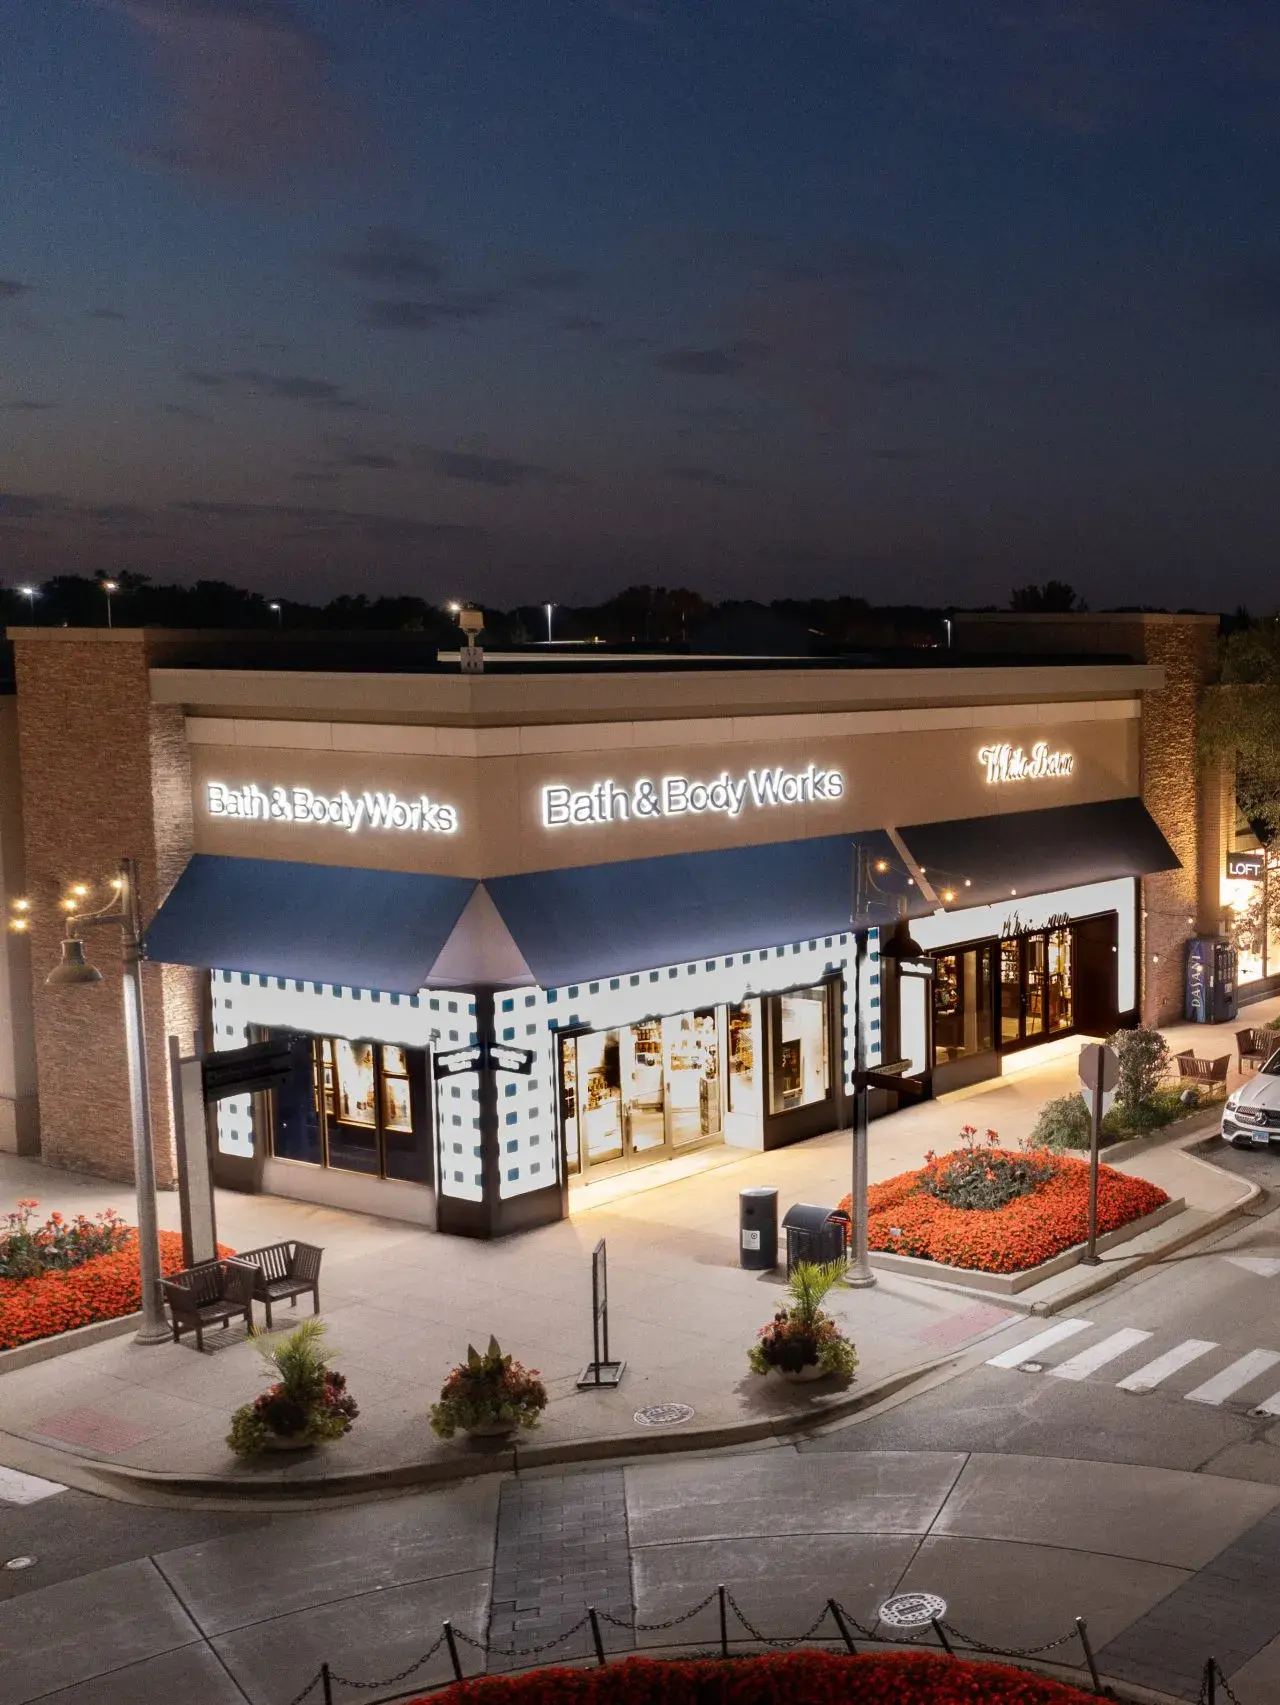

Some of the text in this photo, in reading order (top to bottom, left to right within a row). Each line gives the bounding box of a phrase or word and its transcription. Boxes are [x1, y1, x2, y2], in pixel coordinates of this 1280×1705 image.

[206, 782, 269, 819] Bath
[292, 787, 362, 833] Body
[362, 791, 460, 834] Works
[543, 764, 844, 828] Bath & Body Works
[1229, 862, 1261, 876] LOFT
[1191, 955, 1203, 1008] DASANI
